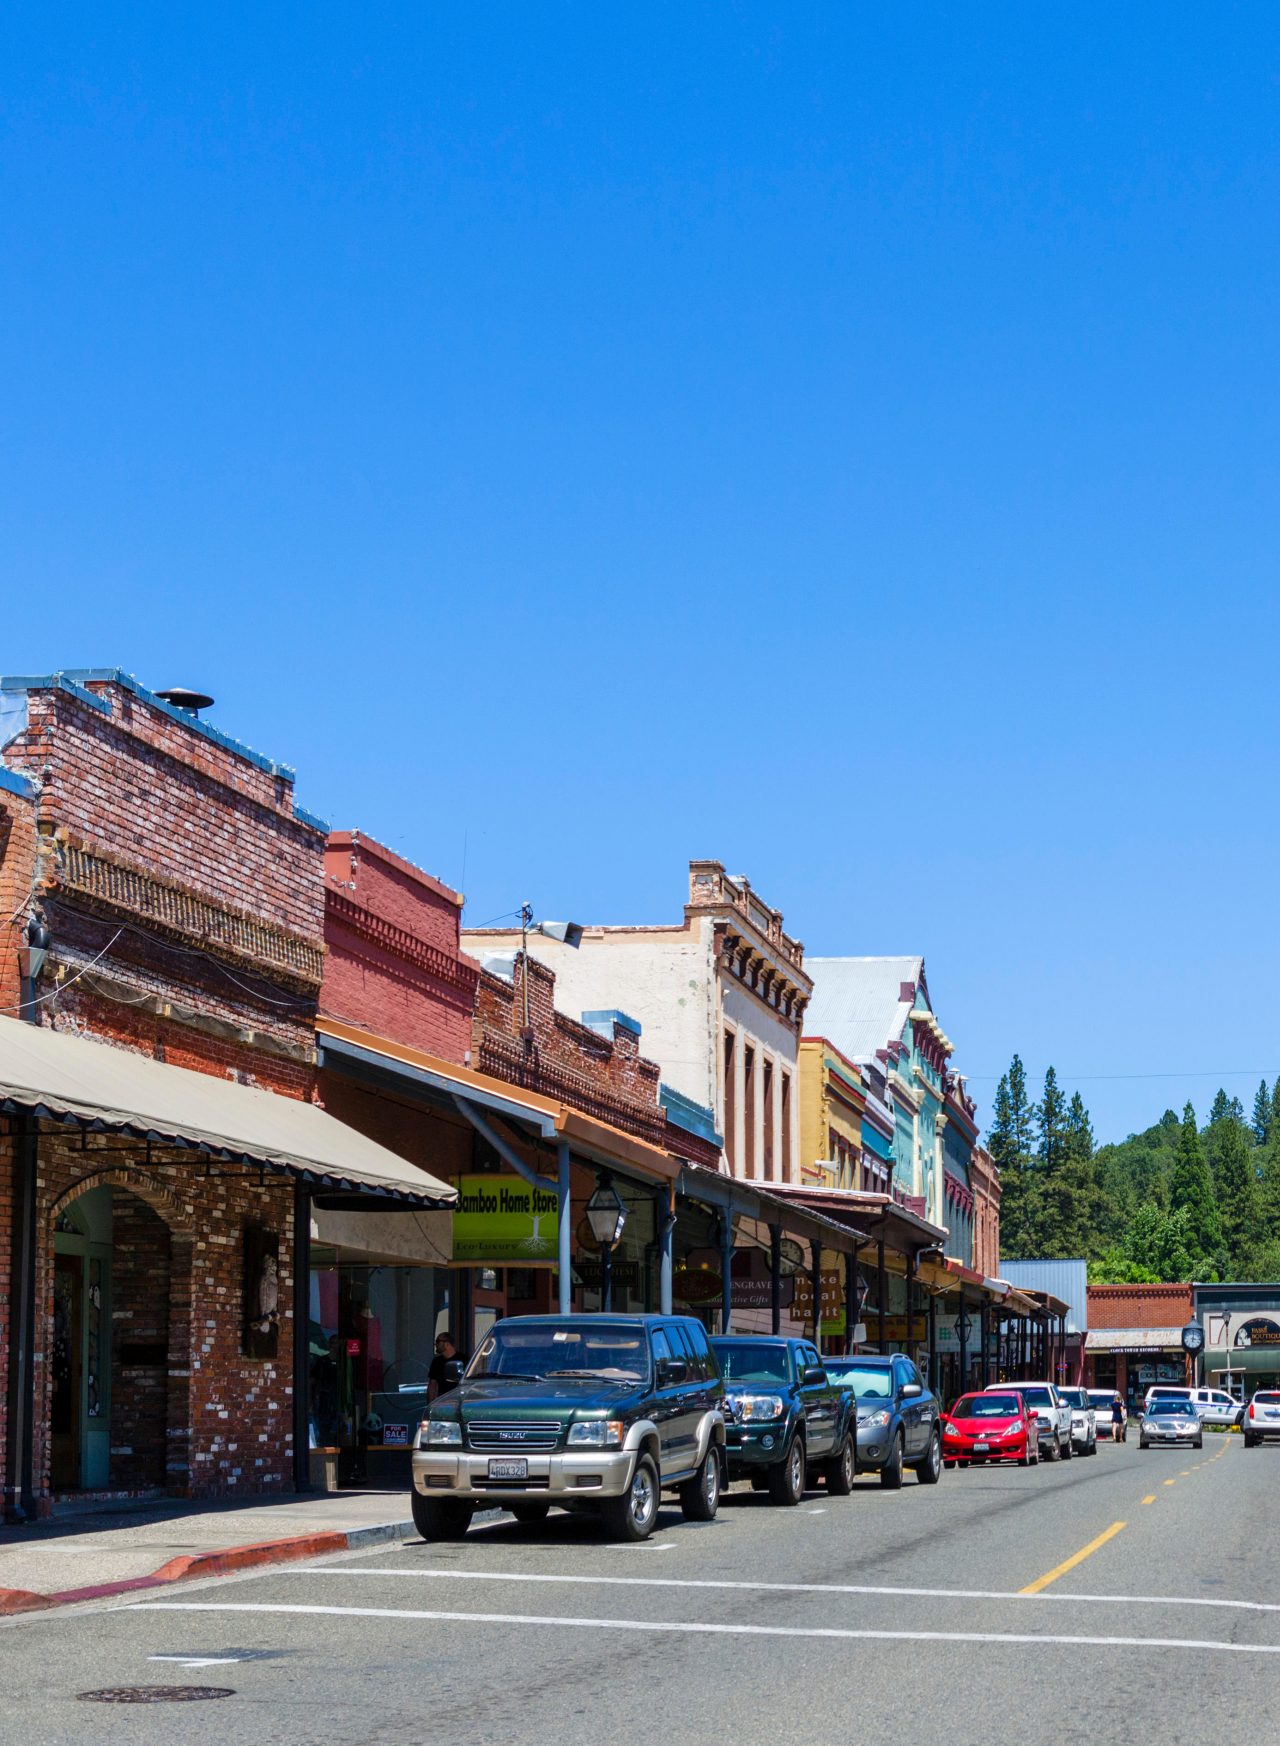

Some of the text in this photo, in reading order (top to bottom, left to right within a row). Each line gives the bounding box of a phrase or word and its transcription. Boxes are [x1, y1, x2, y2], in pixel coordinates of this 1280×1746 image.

[455, 1187, 557, 1213] Bamboo Home Store
[729, 1281, 785, 1289] ENGRAVES
[385, 1430, 407, 1438] SALE
[500, 1431, 526, 1439] ISUZU
